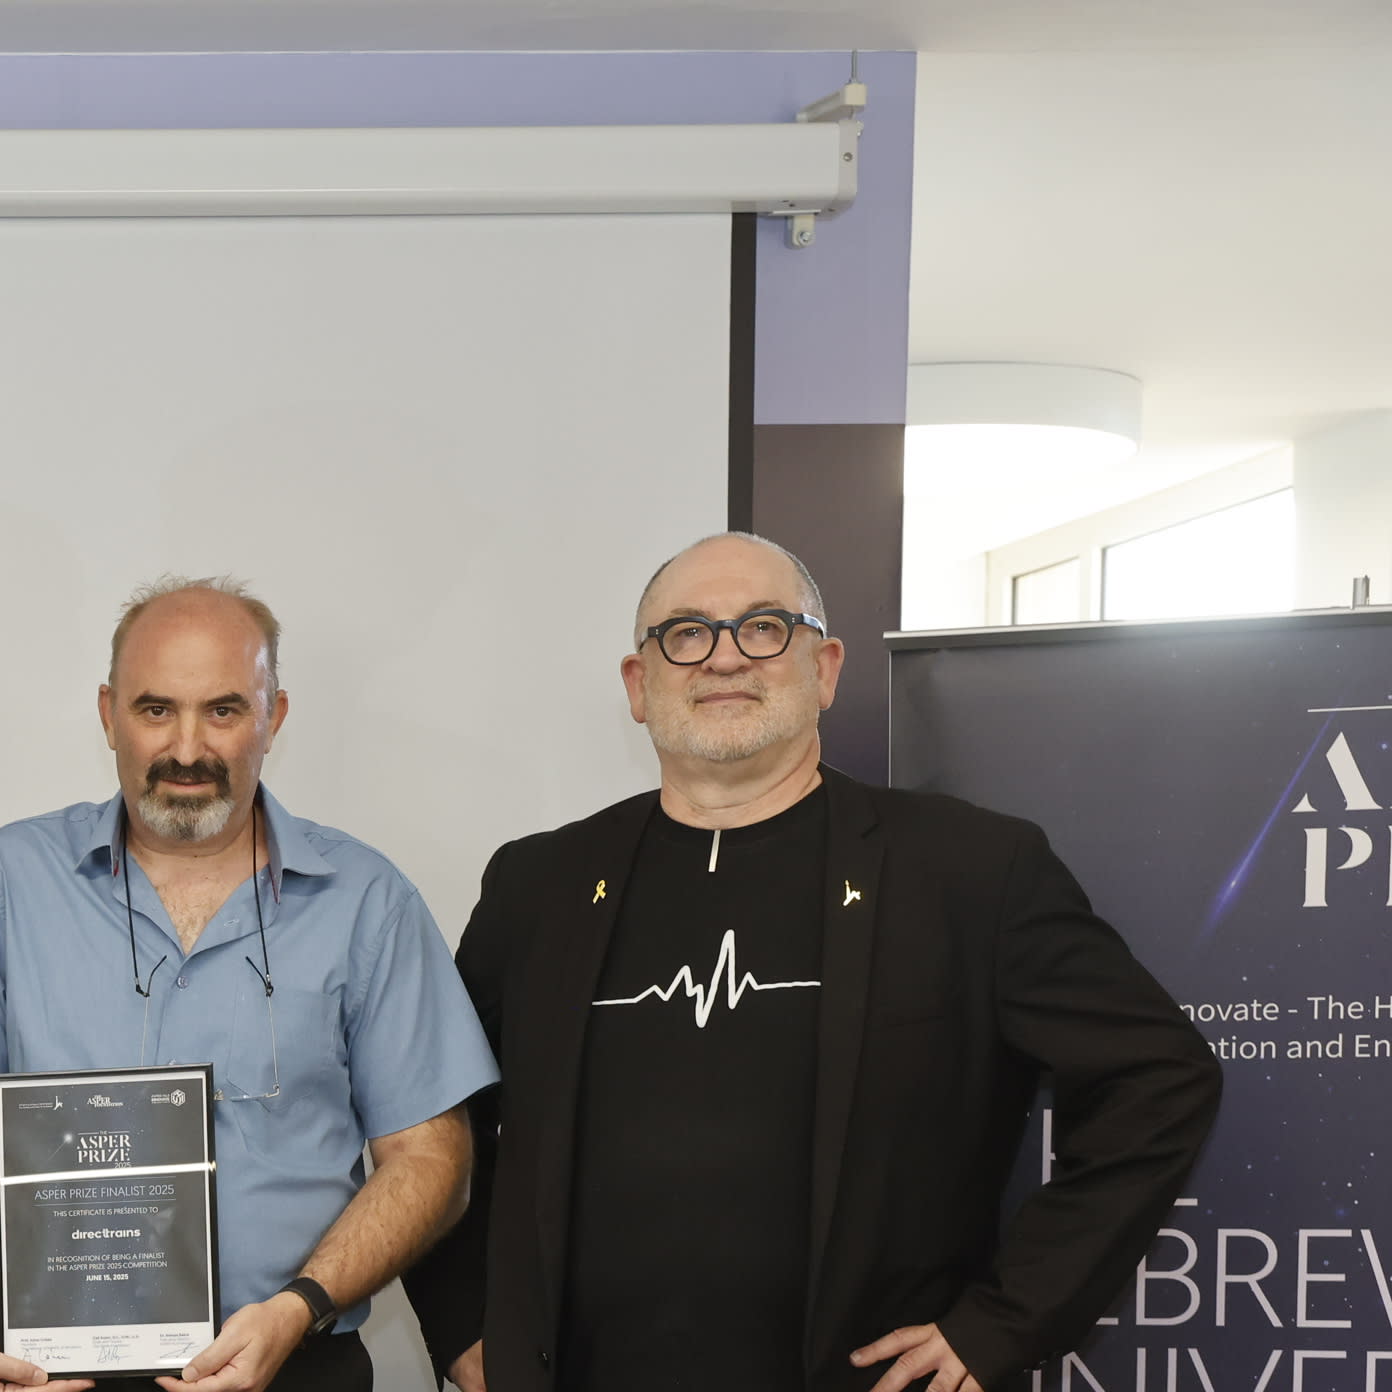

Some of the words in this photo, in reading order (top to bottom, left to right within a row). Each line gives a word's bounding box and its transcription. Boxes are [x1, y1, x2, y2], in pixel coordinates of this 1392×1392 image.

[1307, 995, 1364, 1020] The
[1286, 1034, 1343, 1058] and
[76, 1134, 132, 1149] ASPER
[78, 1148, 130, 1163] PRIZE
[34, 1189, 66, 1200] ASPER
[69, 1188, 97, 1199] PRIZE
[100, 1186, 145, 1197] FINALIST
[148, 1184, 175, 1195] 2025
[68, 1209, 106, 1217] CERTIFICATE
[114, 1206, 148, 1215] PRESENTED
[104, 1274, 112, 1282] 15,
[113, 1273, 128, 1281] 2025
